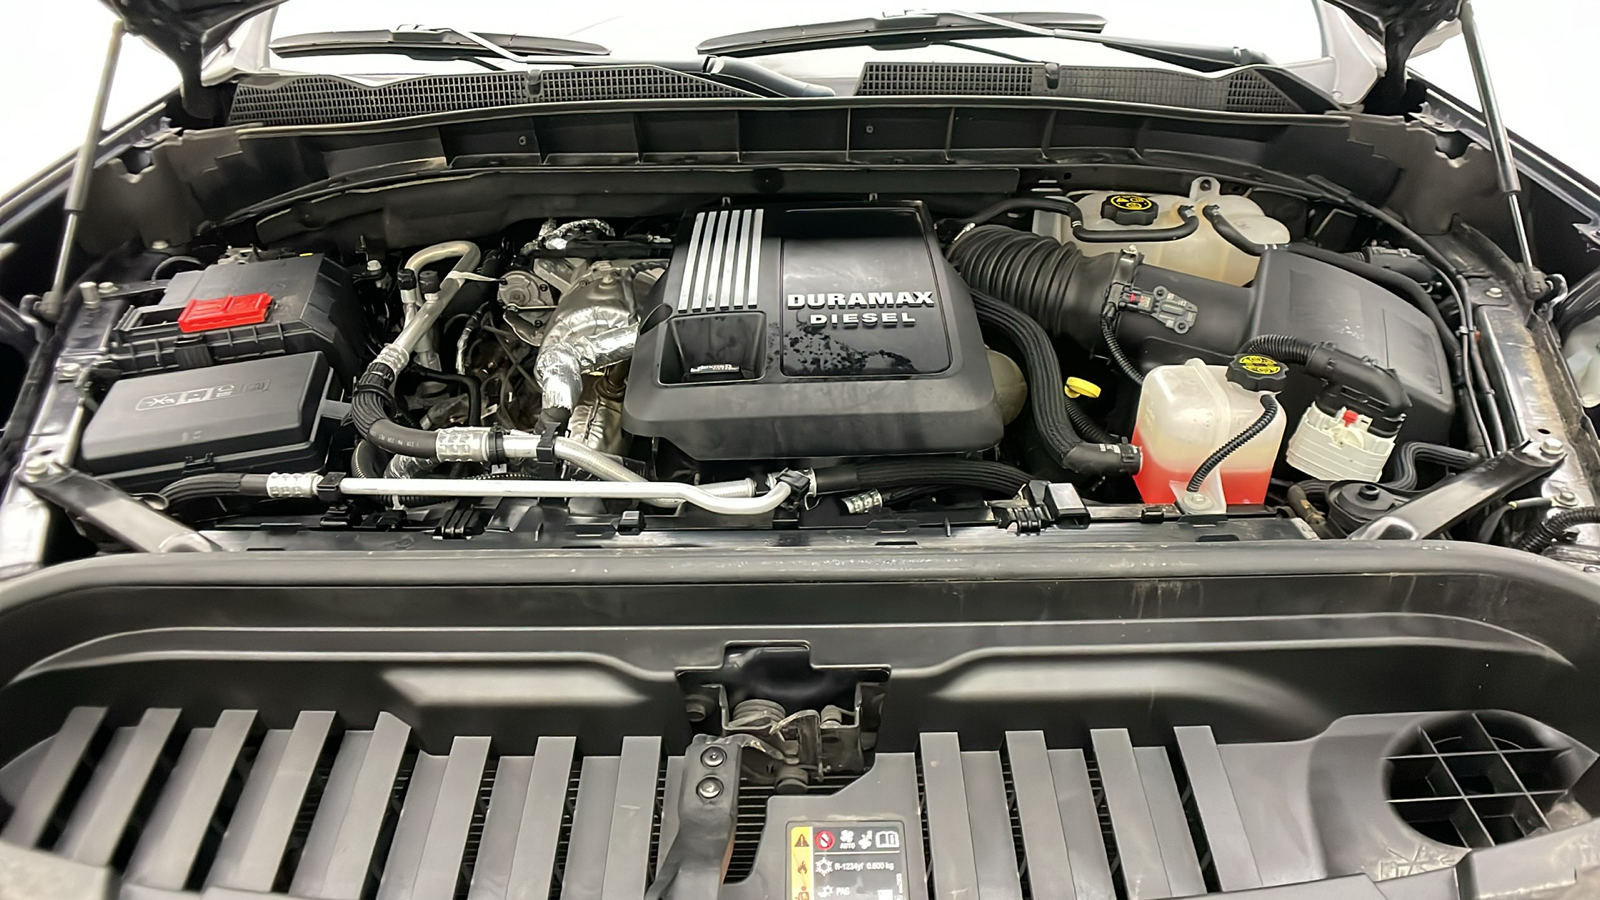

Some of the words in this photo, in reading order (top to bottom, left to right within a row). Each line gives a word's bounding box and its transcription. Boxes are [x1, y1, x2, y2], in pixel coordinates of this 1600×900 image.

[787, 291, 935, 309] DURAMAX
[810, 312, 916, 328] DIESEL
[886, 861, 894, 871] kg
